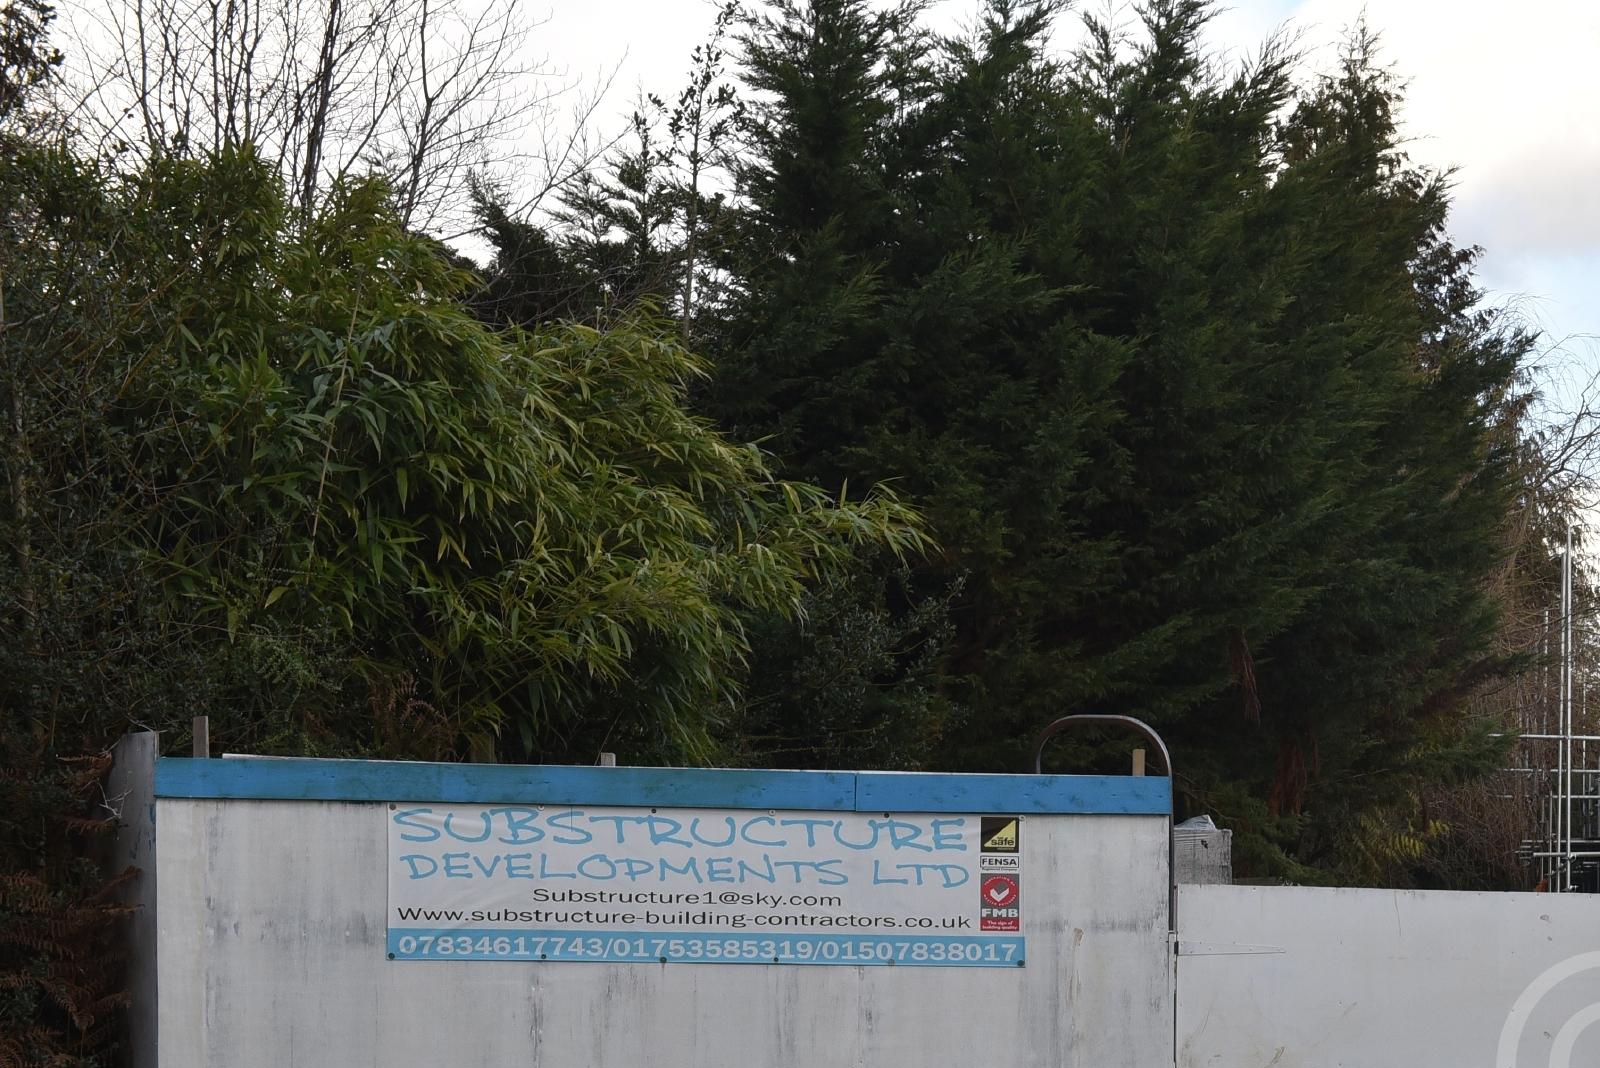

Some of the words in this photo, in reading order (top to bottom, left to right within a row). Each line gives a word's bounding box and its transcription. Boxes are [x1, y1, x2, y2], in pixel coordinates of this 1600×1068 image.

[393, 806, 968, 852] SUBSTRUCTURE
[990, 836, 1015, 846] safe
[399, 852, 849, 887] DEVELOPMENTS
[872, 859, 970, 889] LTD
[981, 858, 1017, 866] FENSA
[532, 888, 842, 908] Substructure1@sky.com
[397, 907, 972, 929] Www.substructure-building-contractors.co.uk
[981, 908, 1019, 918] FMB
[398, 935, 1018, 962] 07834617743/01753585319/01507838017
